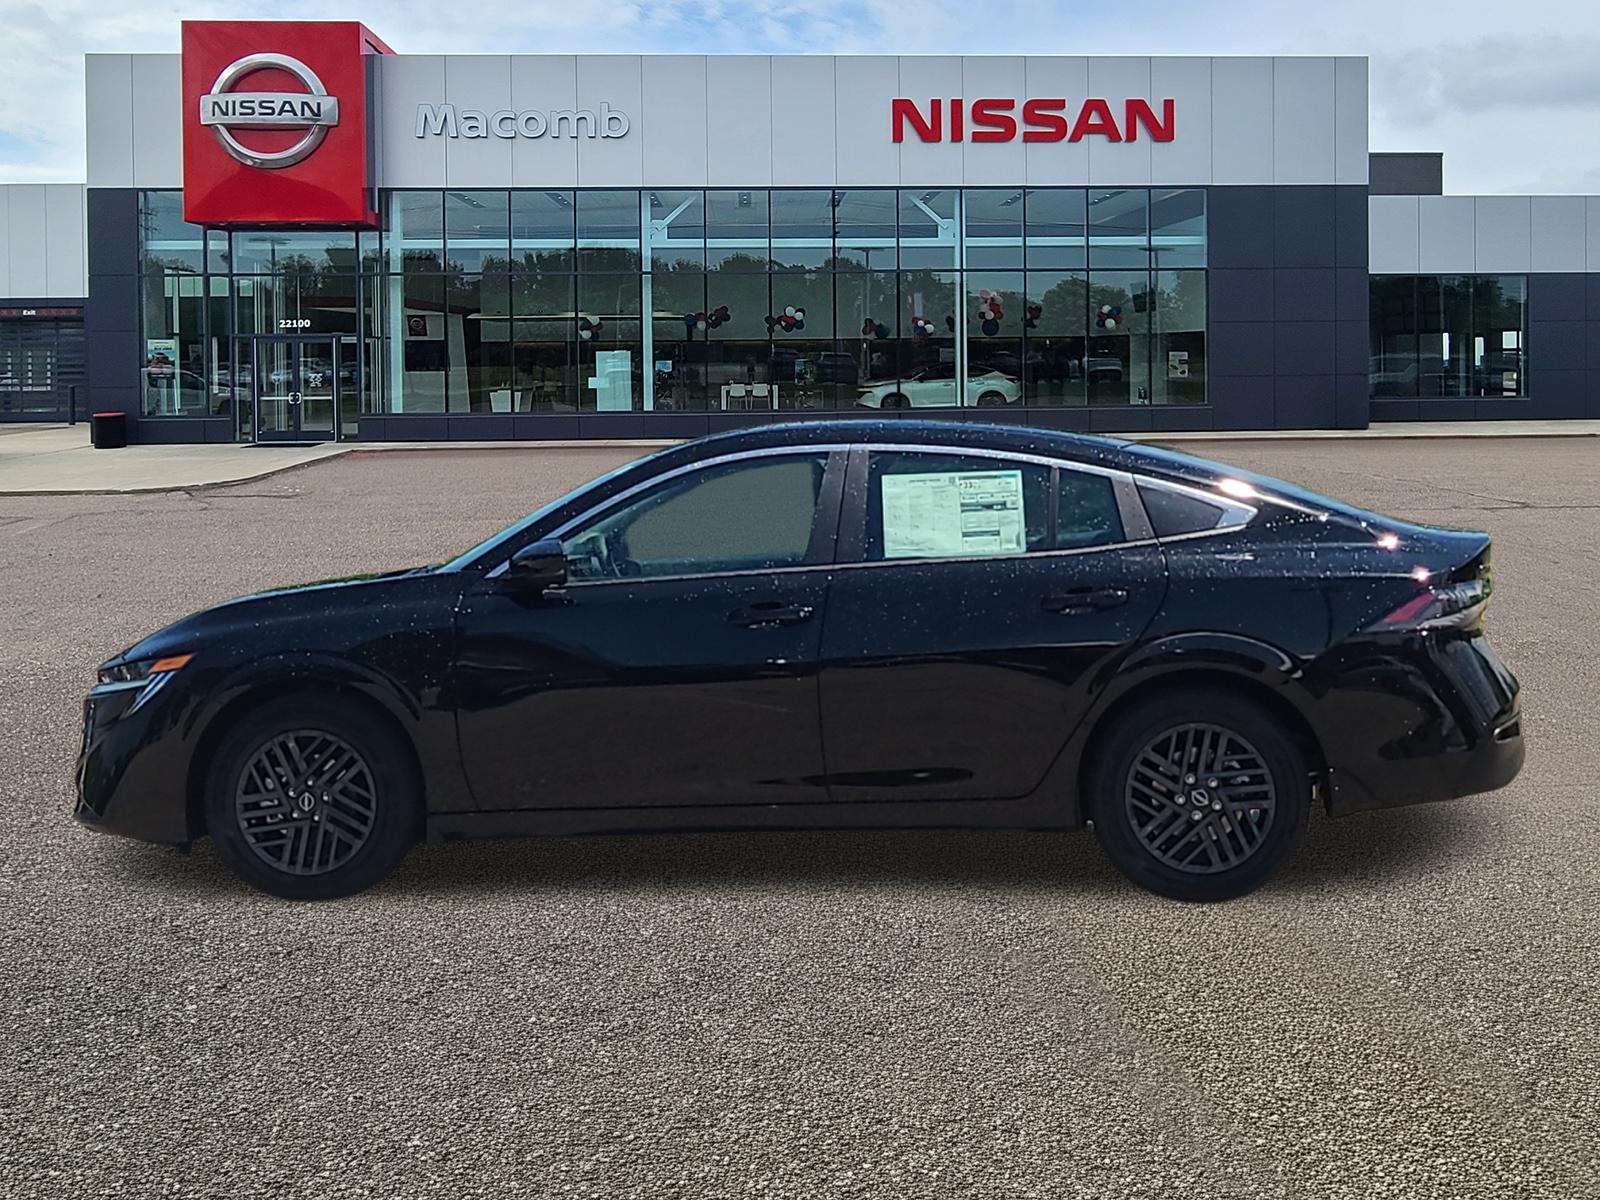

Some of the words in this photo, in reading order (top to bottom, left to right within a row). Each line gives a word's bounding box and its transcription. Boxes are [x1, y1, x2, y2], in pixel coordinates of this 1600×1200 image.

[212, 99, 322, 118] NISSAN
[415, 101, 630, 139] Macomb
[892, 98, 1176, 142] NISSAN
[279, 319, 311, 328] 22100
